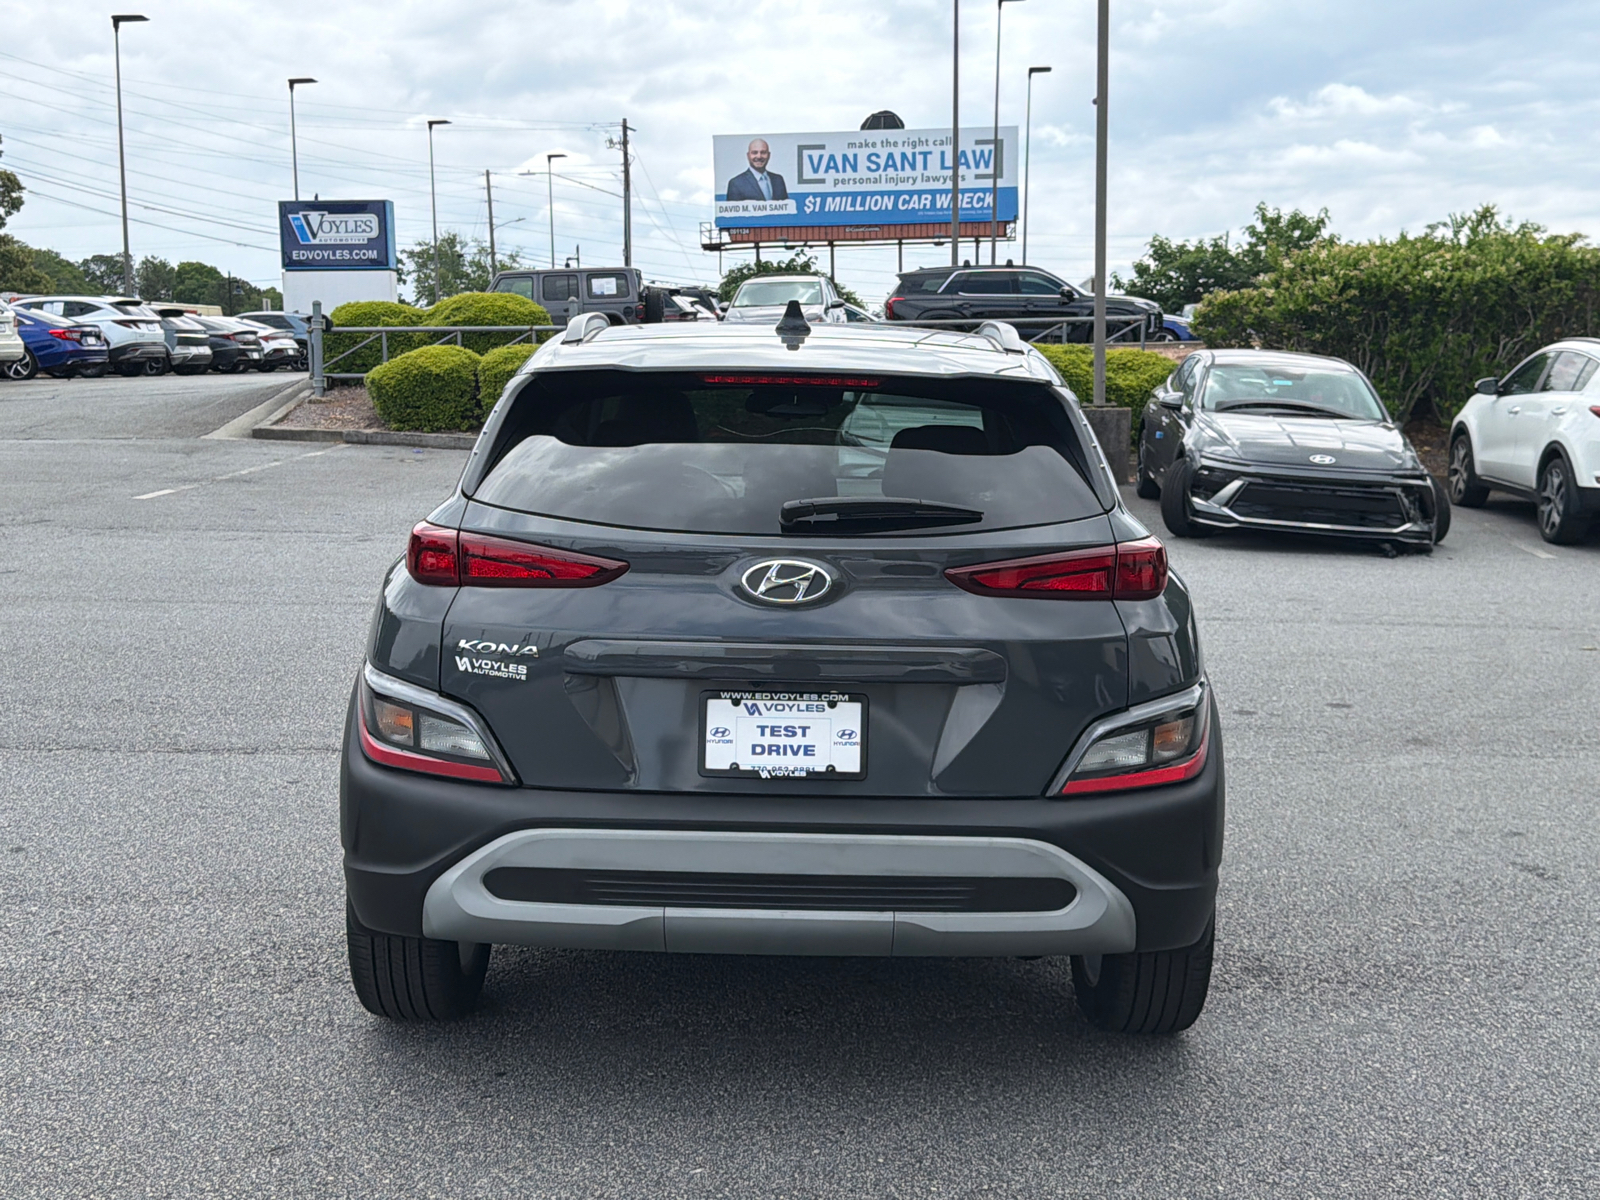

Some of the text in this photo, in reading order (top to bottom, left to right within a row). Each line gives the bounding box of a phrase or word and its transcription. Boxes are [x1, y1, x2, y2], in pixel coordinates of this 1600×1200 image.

[847, 136, 953, 150] make the right call
[807, 149, 993, 174] VAN SANT LAW
[833, 172, 966, 188] personal injury lawyes
[719, 203, 789, 213] DAVID M. VAN SANT
[804, 195, 821, 214] $1
[825, 195, 895, 212] MILLION
[898, 194, 931, 211] CAR
[301, 213, 374, 240] VOYLES
[292, 249, 378, 260] EDVOYLES.COM
[456, 639, 539, 657] KONA
[472, 658, 527, 674] VOYLES
[472, 668, 527, 681] AUTOMOTIVE
[763, 703, 826, 713] VOYLES
[756, 725, 811, 738] TEST
[751, 744, 816, 757] DRIVE
